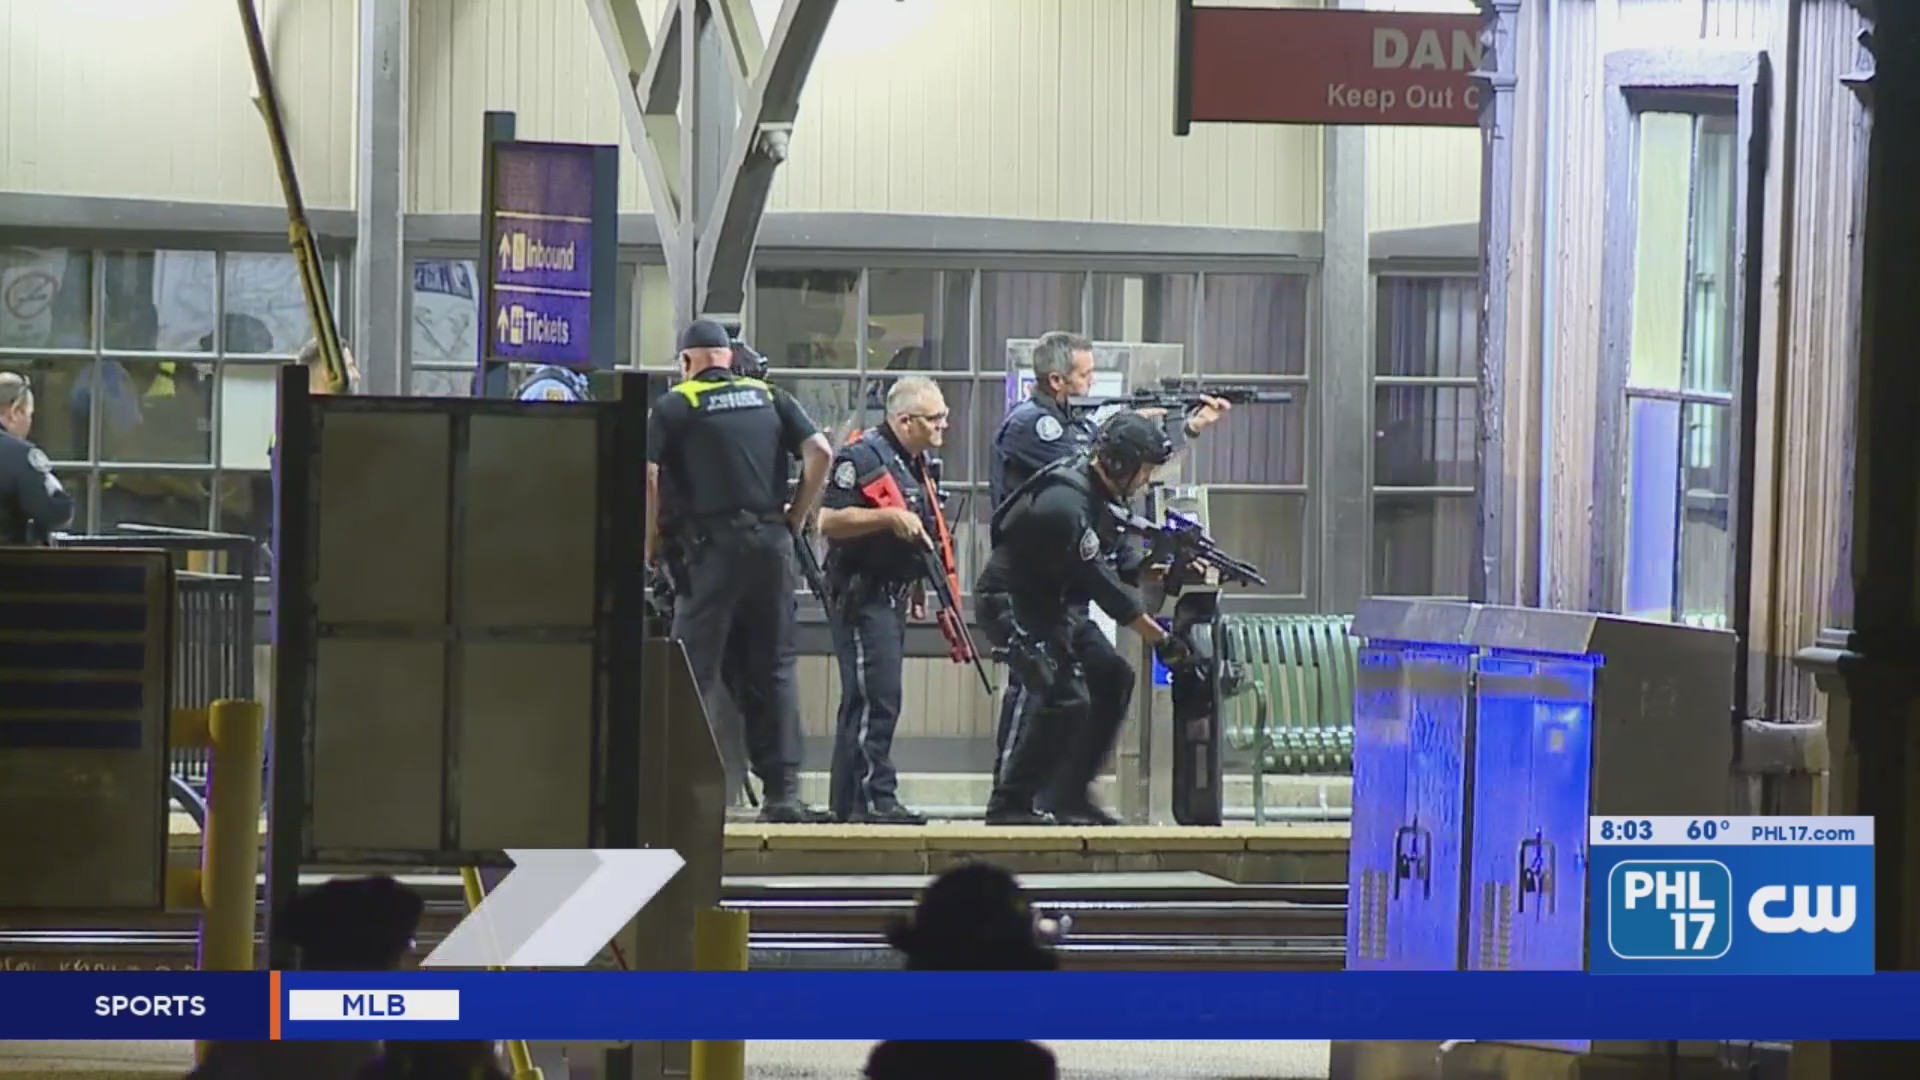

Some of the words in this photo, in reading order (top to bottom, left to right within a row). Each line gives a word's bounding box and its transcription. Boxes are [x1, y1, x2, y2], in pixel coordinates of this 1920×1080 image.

[1328, 84, 1396, 113] Keep
[1406, 86, 1453, 109] Out
[526, 240, 576, 271] Inbound
[525, 310, 570, 345] Tickets
